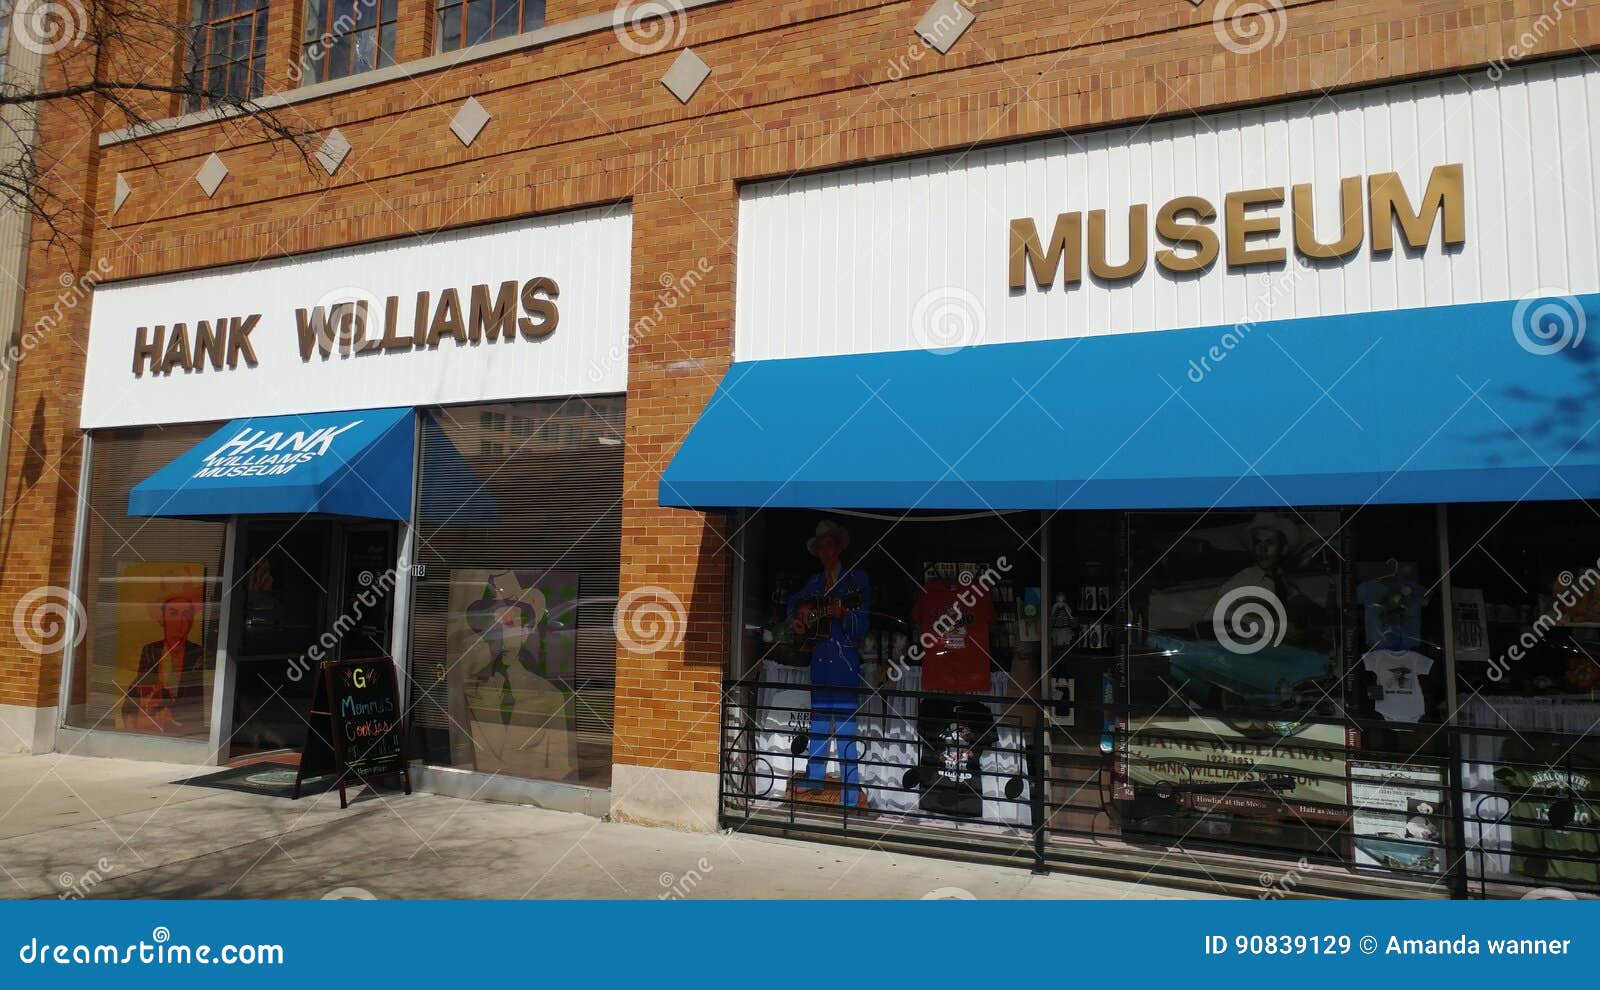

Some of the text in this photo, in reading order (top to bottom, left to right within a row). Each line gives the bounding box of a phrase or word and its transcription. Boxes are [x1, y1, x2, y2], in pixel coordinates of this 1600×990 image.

[1009, 163, 1465, 289] MUSEUM
[132, 276, 559, 376] HANK WILLIAMS
[202, 419, 364, 462] HANK
[193, 464, 297, 478] MUSEUM
[205, 452, 316, 467] WILLIAMS
[1149, 760, 1185, 775] HANK
[1190, 765, 1255, 781] WILLIAMS
